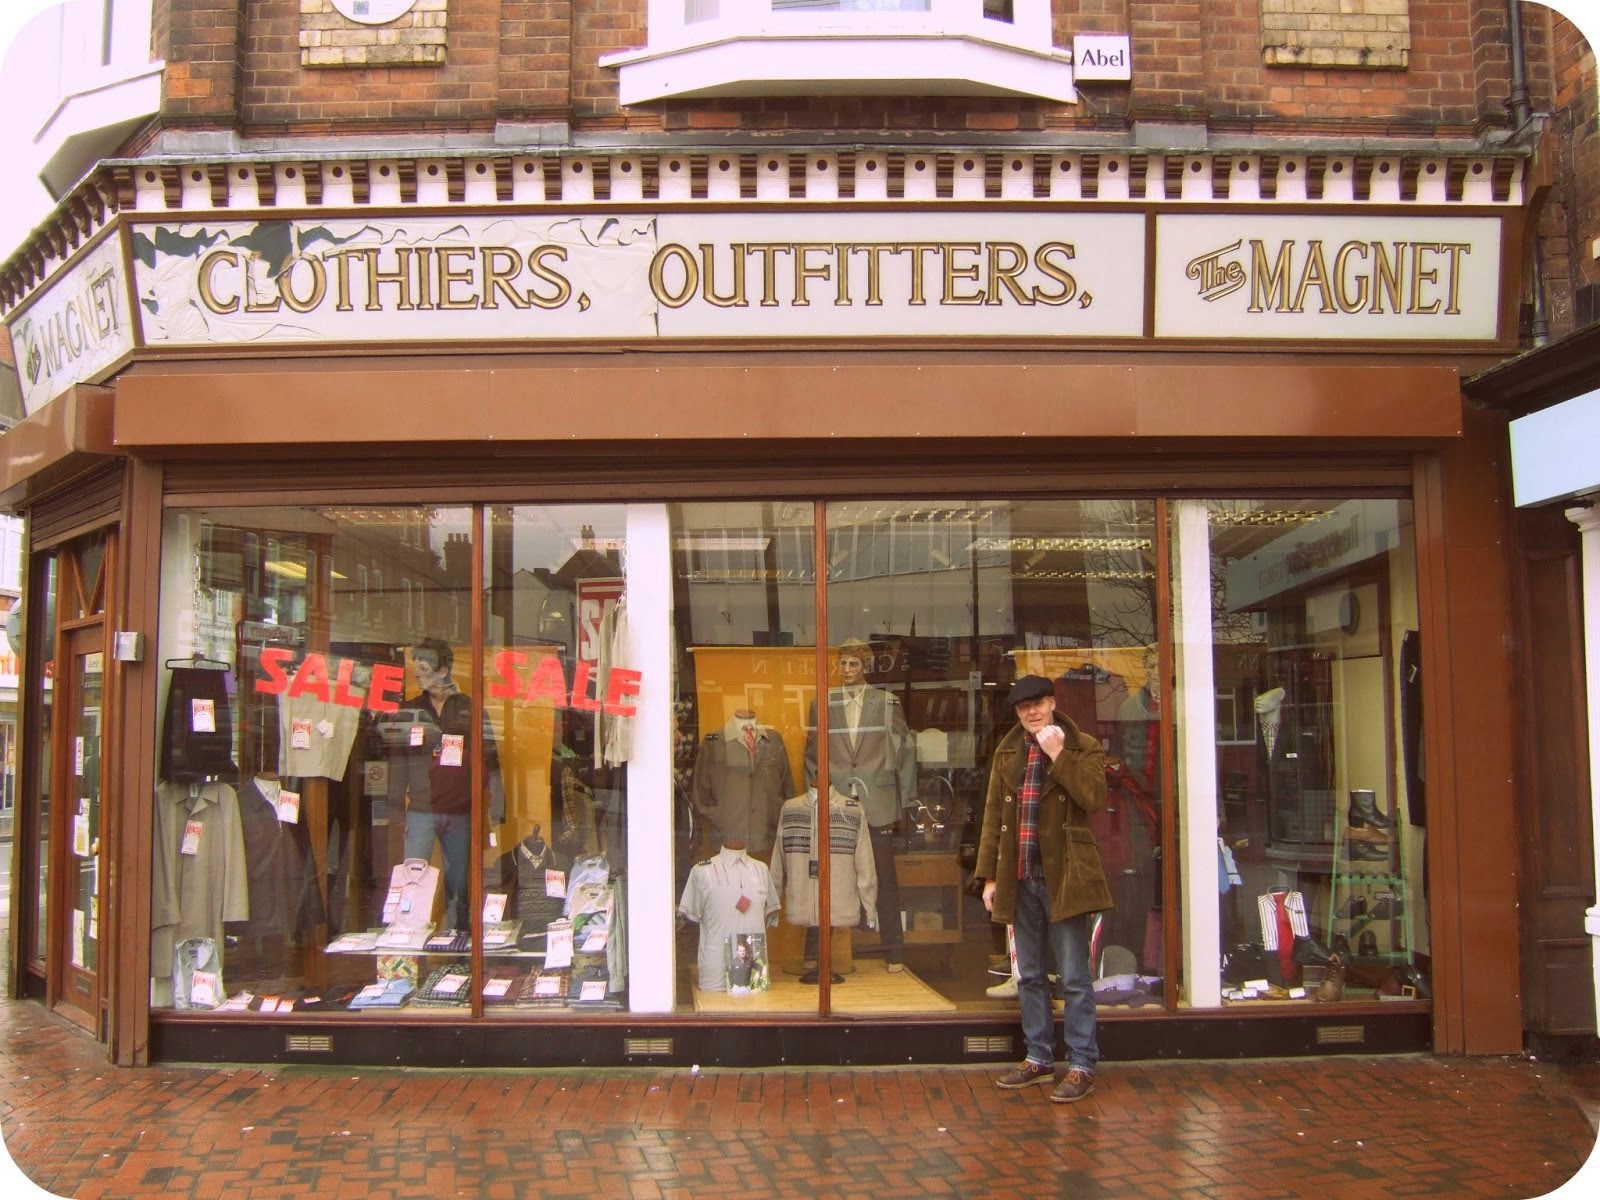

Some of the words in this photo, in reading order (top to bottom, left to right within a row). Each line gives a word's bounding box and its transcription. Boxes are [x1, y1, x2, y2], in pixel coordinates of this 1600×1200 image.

[1081, 49, 1124, 67] Abel
[196, 244, 591, 314] CLOTHIERS,
[648, 241, 1093, 309] OUTFITTERS,
[1186, 239, 1246, 302] The
[1247, 240, 1471, 315] MAGNET
[39, 266, 120, 378] MAGNET
[255, 647, 405, 714] SALE
[489, 651, 642, 717] SALE
